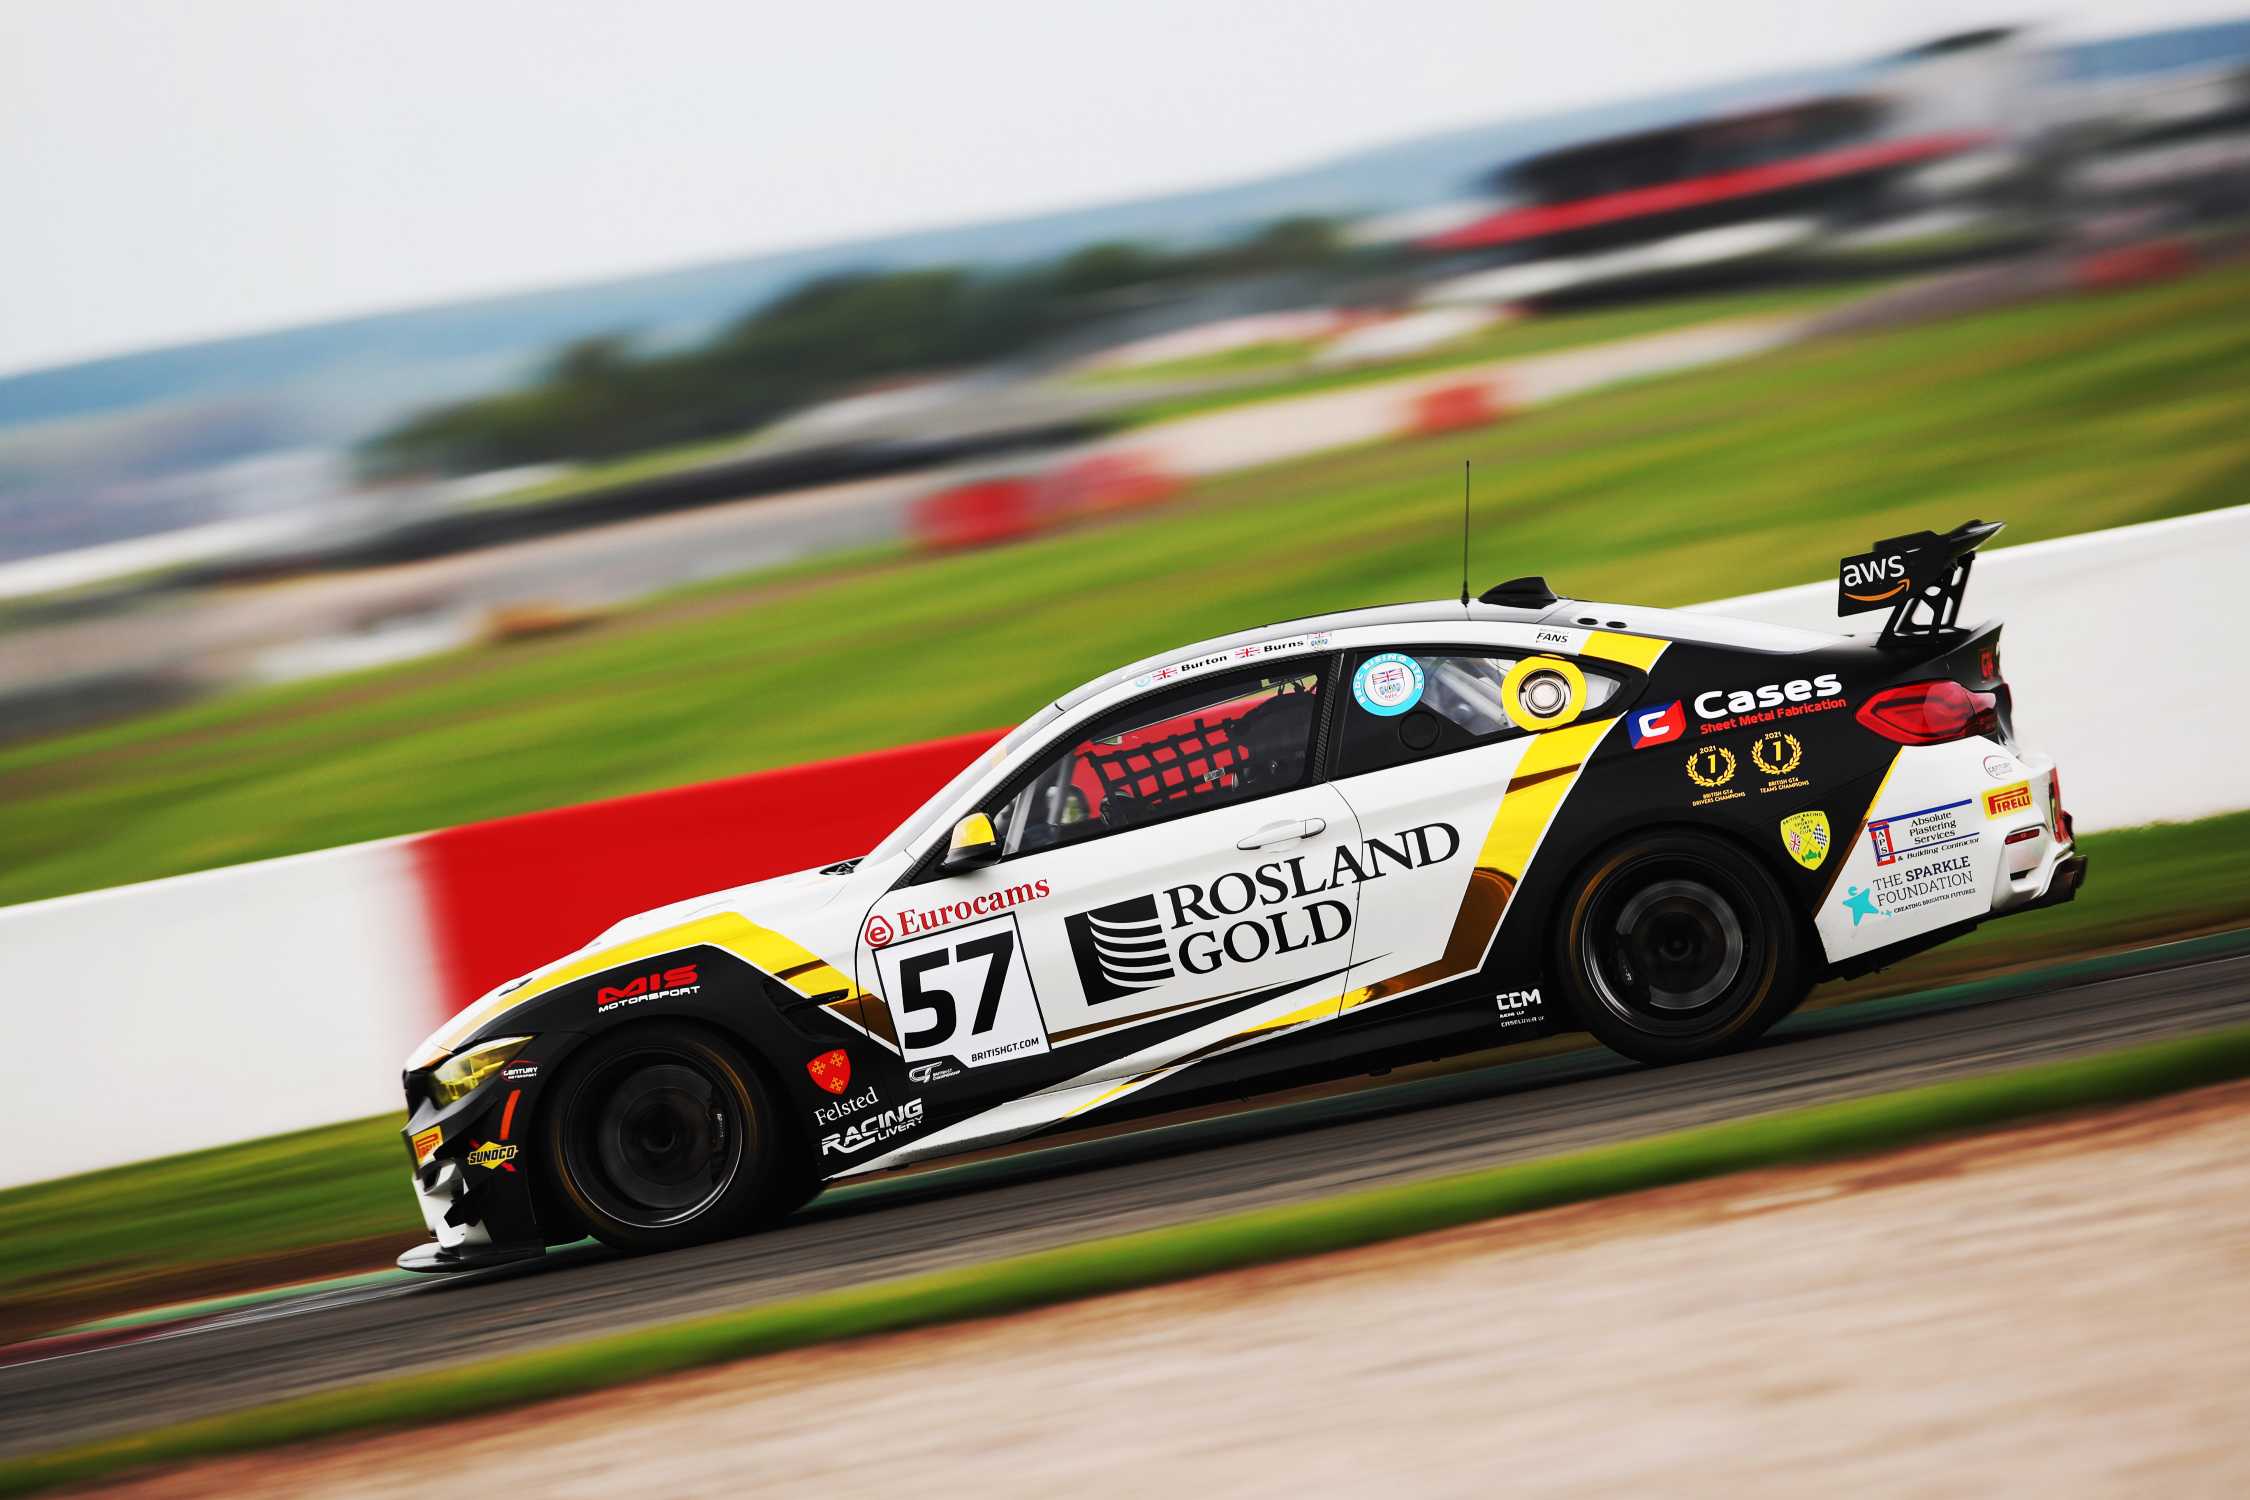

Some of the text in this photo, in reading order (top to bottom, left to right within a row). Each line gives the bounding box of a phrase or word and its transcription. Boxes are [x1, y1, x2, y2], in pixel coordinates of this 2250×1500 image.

[1843, 556, 1905, 587] aws
[1264, 640, 1304, 653] Burns
[1536, 632, 1568, 643] FANS
[1181, 655, 1227, 672] Burton
[1694, 673, 1842, 719] Cases
[1700, 698, 1847, 735] Sheet Metal Fabrication
[1764, 731, 1781, 740] 2021
[1700, 745, 1716, 754] 2021
[1773, 741, 1781, 761] 1
[1707, 754, 1716, 773] 1
[1768, 779, 1788, 787] BRITISH
[1778, 780, 1809, 790] CHAMPIONS
[1692, 792, 1746, 807] DRIVERS CHAMPIONS
[1703, 791, 1722, 799] BRITISH
[1988, 787, 2030, 815] PIRELLI
[1909, 820, 1957, 837] Plastering
[1911, 811, 1952, 827] Absolute
[1907, 847, 1939, 859] Building
[1941, 838, 1979, 851] Contractor
[1914, 830, 1956, 845] Services
[1163, 822, 1460, 930] ROSLAND
[1873, 856, 1971, 891] THE SPARKLE
[1877, 871, 1974, 906] FOUNDATION
[897, 878, 1050, 936] Eurocams
[1893, 902, 1922, 914] CREATING
[1950, 888, 1976, 899] FUTURES
[1178, 900, 1352, 975] GOLD
[597, 964, 698, 1005] MIS
[900, 930, 1013, 1049] 57
[598, 986, 701, 1013] MOTORSPORT
[1496, 988, 1542, 1010] CCM
[971, 1037, 1039, 1062] BRITISHGT.COM
[503, 1066, 538, 1076] CENTURY
[814, 1086, 879, 1126] Felsted
[822, 1098, 923, 1156] RACING
[878, 1115, 923, 1141] LIVERY
[470, 1146, 516, 1164] SUNOCO
